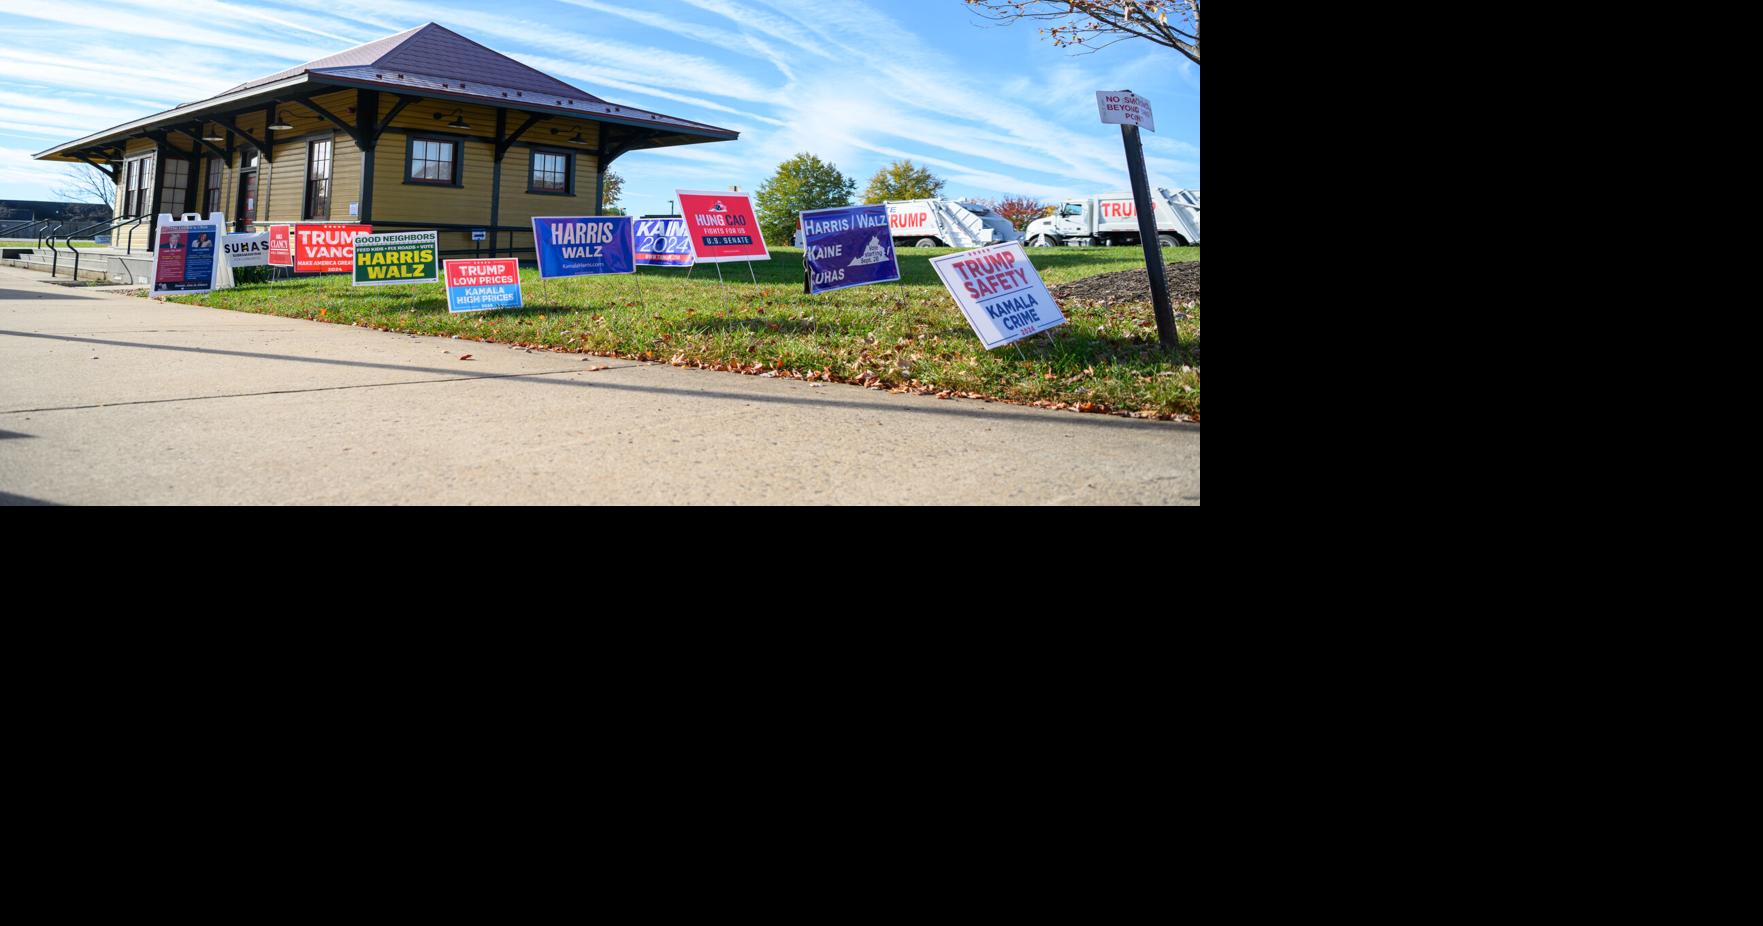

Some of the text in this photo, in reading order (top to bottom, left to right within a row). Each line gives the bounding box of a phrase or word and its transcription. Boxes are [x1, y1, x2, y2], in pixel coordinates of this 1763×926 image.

[1105, 95, 1120, 103] NO
[695, 214, 746, 226] HUNG CAO
[888, 212, 927, 228] RUMP
[551, 222, 614, 245] HARRIS
[636, 221, 690, 237] KAIN
[355, 233, 435, 244] GOOD NEIGHBORS
[640, 237, 689, 253] 2024
[723, 236, 749, 244] SENATE
[224, 241, 269, 254] SUHAS
[305, 246, 353, 258] VANC
[561, 246, 603, 259] WALZ
[357, 249, 433, 266] HARRIS
[367, 264, 425, 279] WALZ
[458, 265, 505, 276] TRUMP
[952, 250, 1016, 280] TRUMP
[453, 275, 513, 286] LOW PRICES
[963, 267, 1029, 299] SAFETY
[464, 286, 505, 296] KAMALA
[456, 293, 513, 304] HIGH PRICES
[985, 293, 1039, 319] KAMALA
[1002, 308, 1040, 331] CRIME
